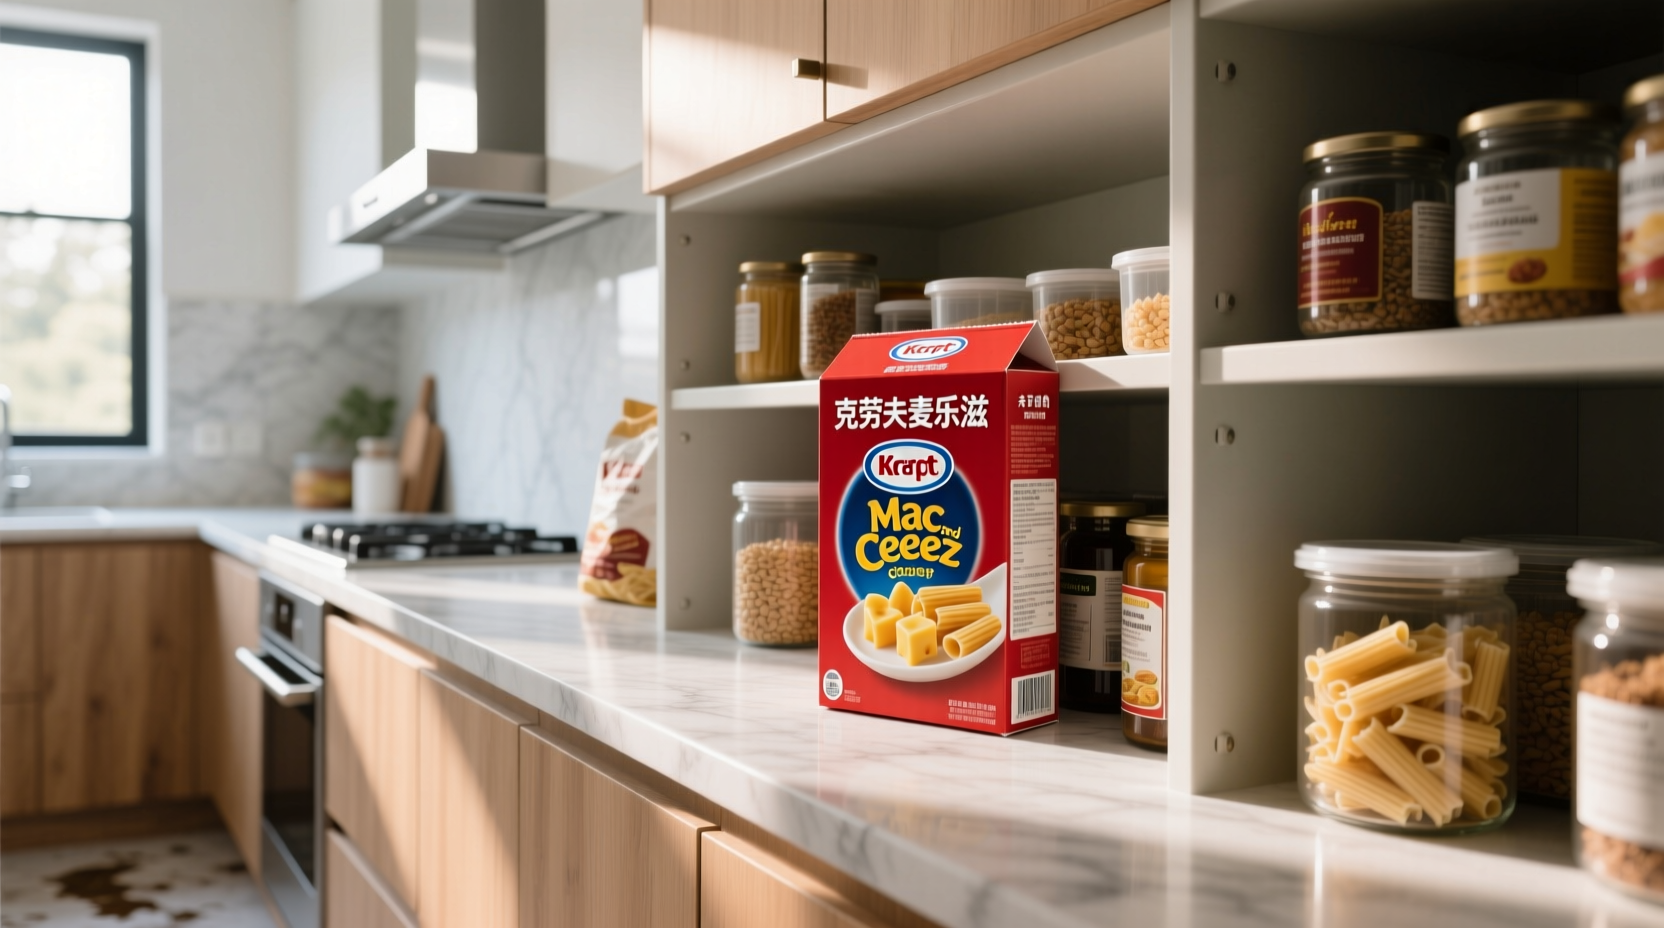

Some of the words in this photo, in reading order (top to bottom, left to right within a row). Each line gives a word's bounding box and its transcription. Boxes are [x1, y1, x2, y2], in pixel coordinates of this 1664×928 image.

[834, 394, 989, 430] 克劳夫麦乐滋
[867, 497, 945, 533] Mac
[855, 532, 963, 572] Ceeez
